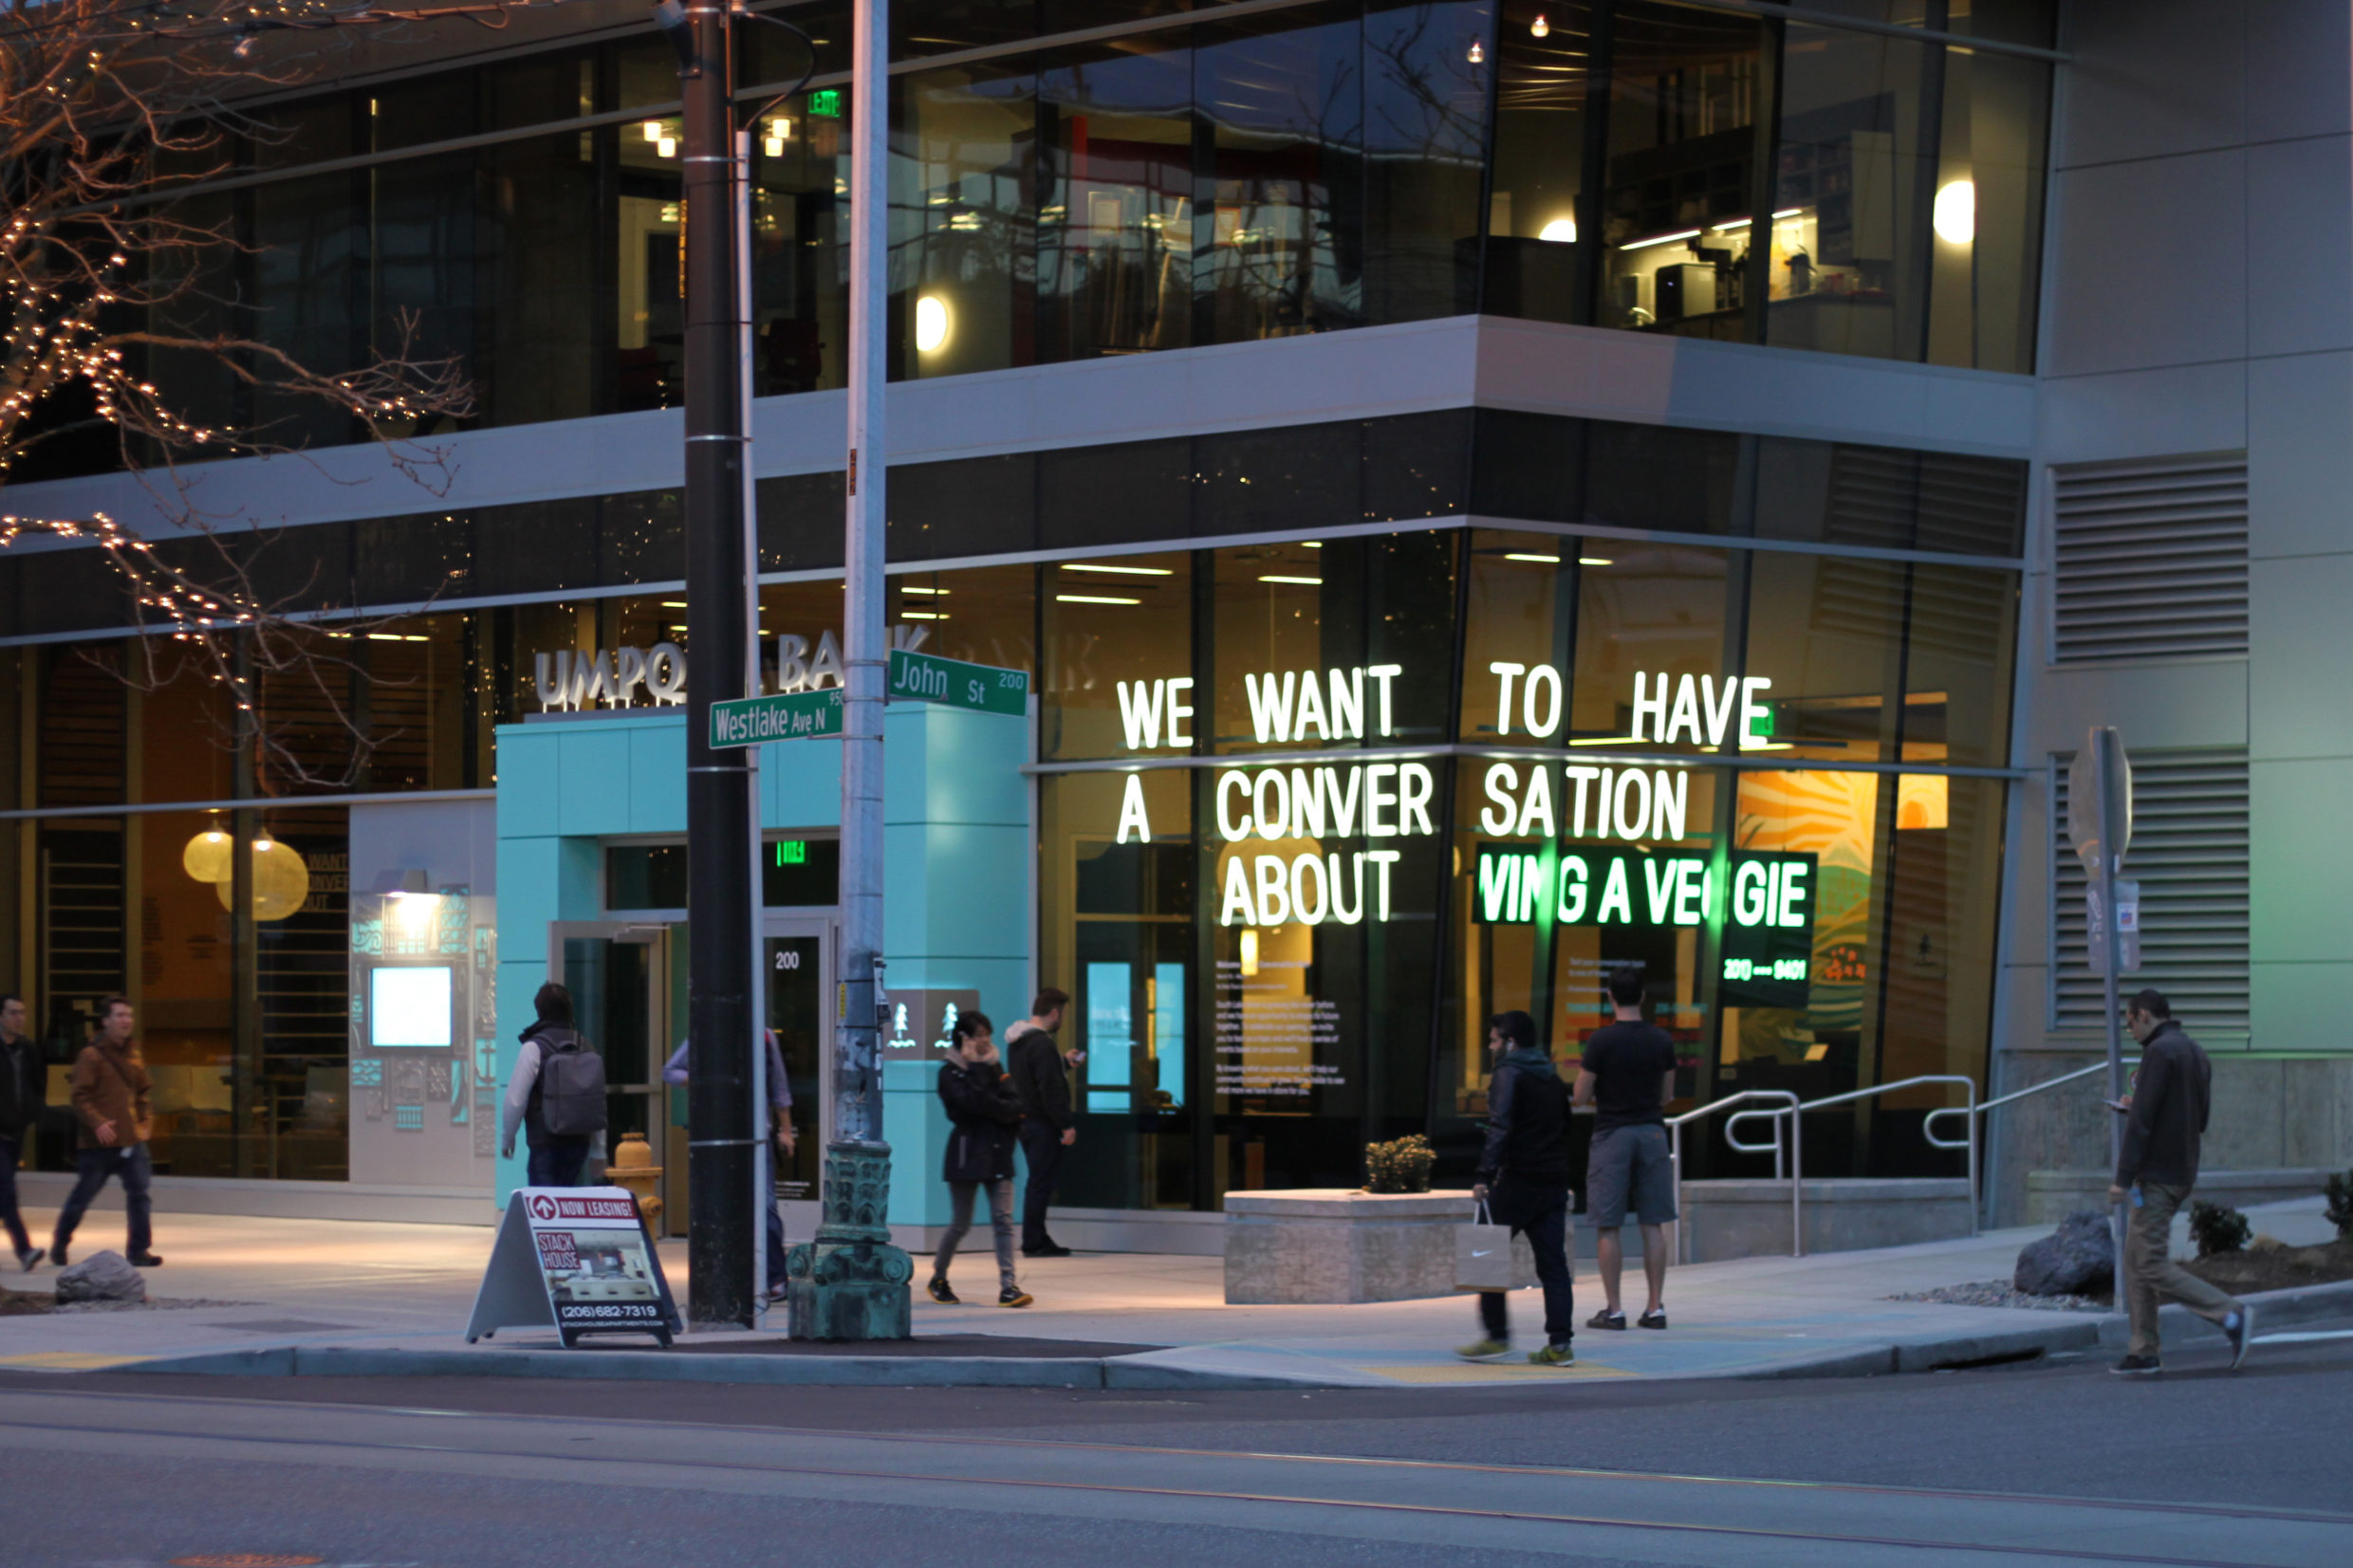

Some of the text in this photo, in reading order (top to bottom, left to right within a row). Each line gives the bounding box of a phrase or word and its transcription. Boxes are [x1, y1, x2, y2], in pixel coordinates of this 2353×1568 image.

[534, 642, 687, 706] UMPQ
[894, 655, 986, 704] John St
[998, 673, 1024, 690] 200
[715, 704, 825, 742] Westlake Ave N
[1117, 661, 1771, 749] WE WANT TO HAVE
[1116, 763, 1688, 844] A CONVER SATION
[1220, 850, 1401, 927] ABOUT
[1597, 857, 1632, 924] A
[775, 951, 800, 969] 200
[560, 1201, 633, 1217] NOW LEASING!
[538, 1234, 575, 1251] STACK
[544, 1252, 581, 1268] HOUSE
